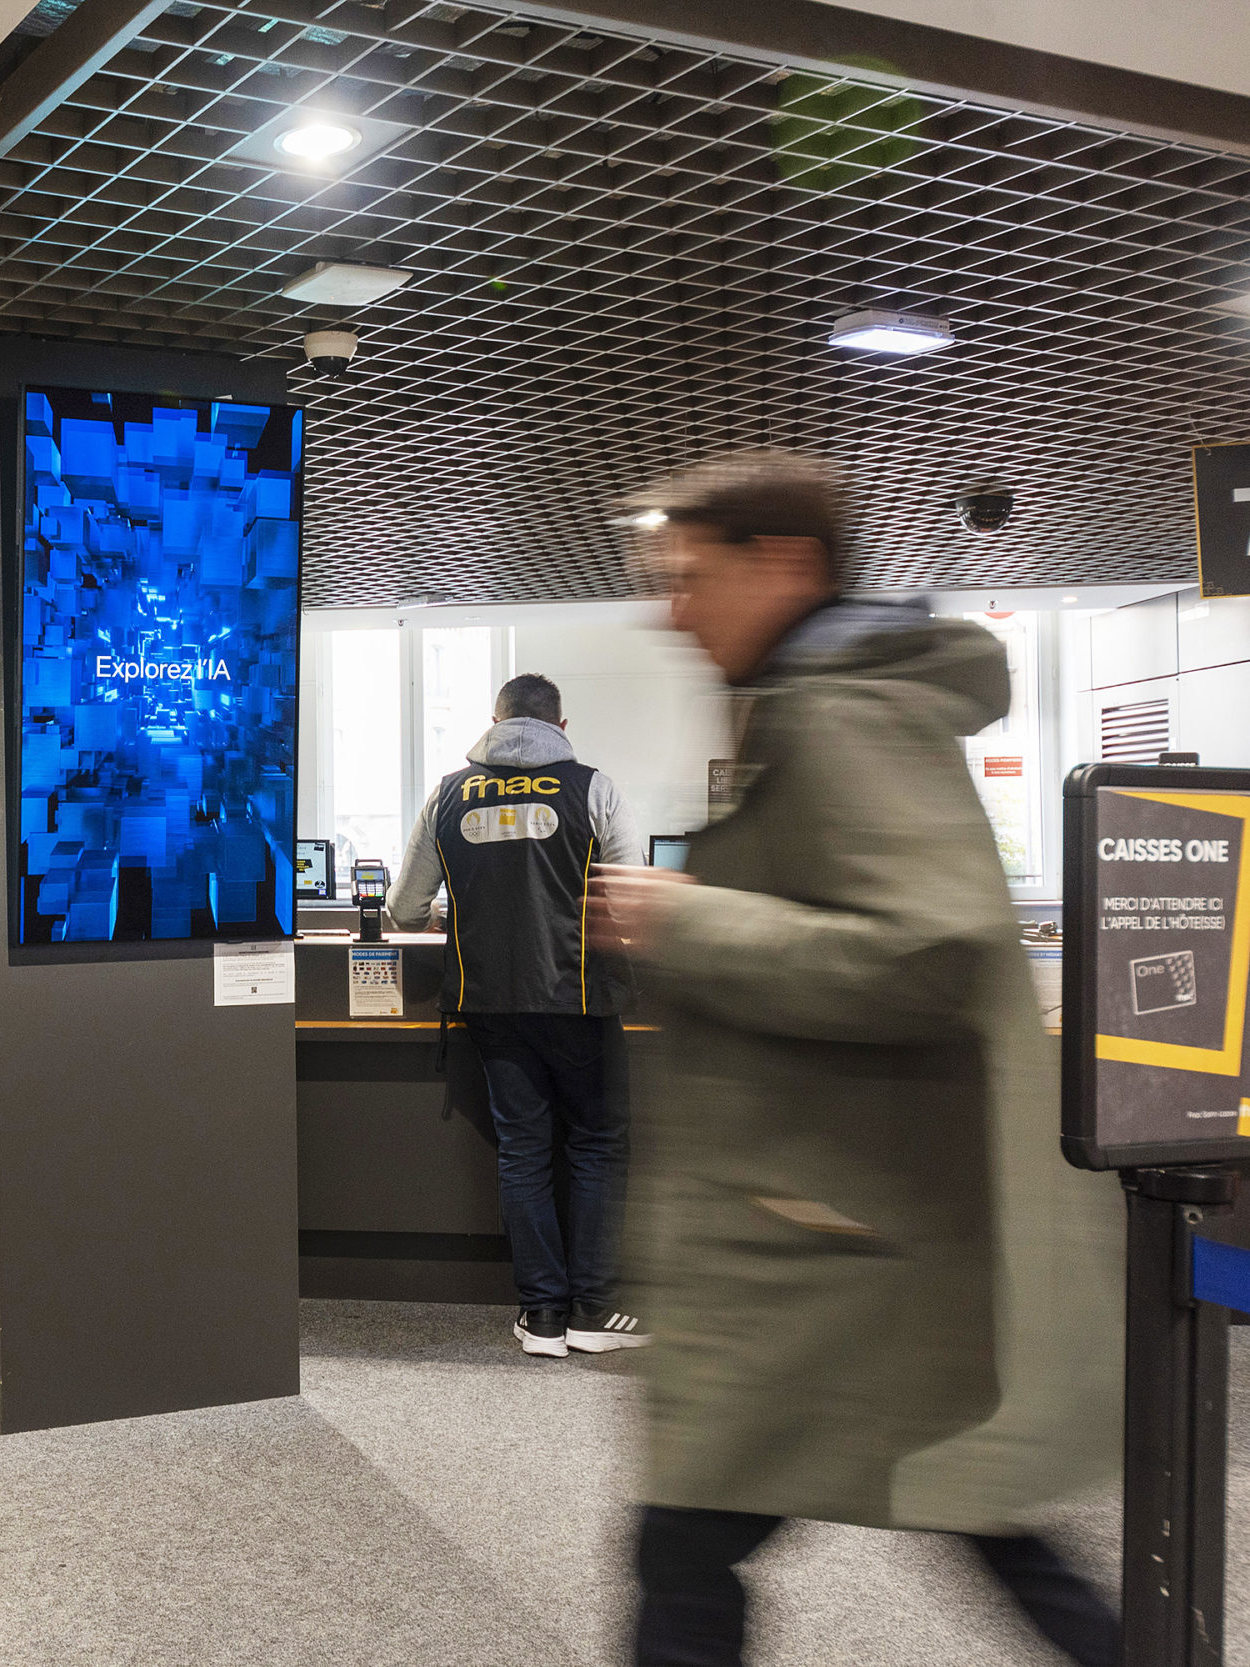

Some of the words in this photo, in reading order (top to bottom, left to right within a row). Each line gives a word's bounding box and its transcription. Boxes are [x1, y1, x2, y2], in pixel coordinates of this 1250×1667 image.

[96, 655, 193, 683] Explorez
[461, 774, 561, 801] fnac
[1099, 838, 1183, 862] CAISSES
[1185, 839, 1229, 862] ONE
[1104, 897, 1138, 910] MERCI
[1140, 897, 1207, 910] D'ATTENDRE
[1209, 897, 1224, 910] ICI
[1101, 916, 1143, 930] L'APPEL
[1145, 916, 1161, 929] DE
[1162, 913, 1226, 930] L'HÔTE(SSE)
[1136, 964, 1165, 977] One
